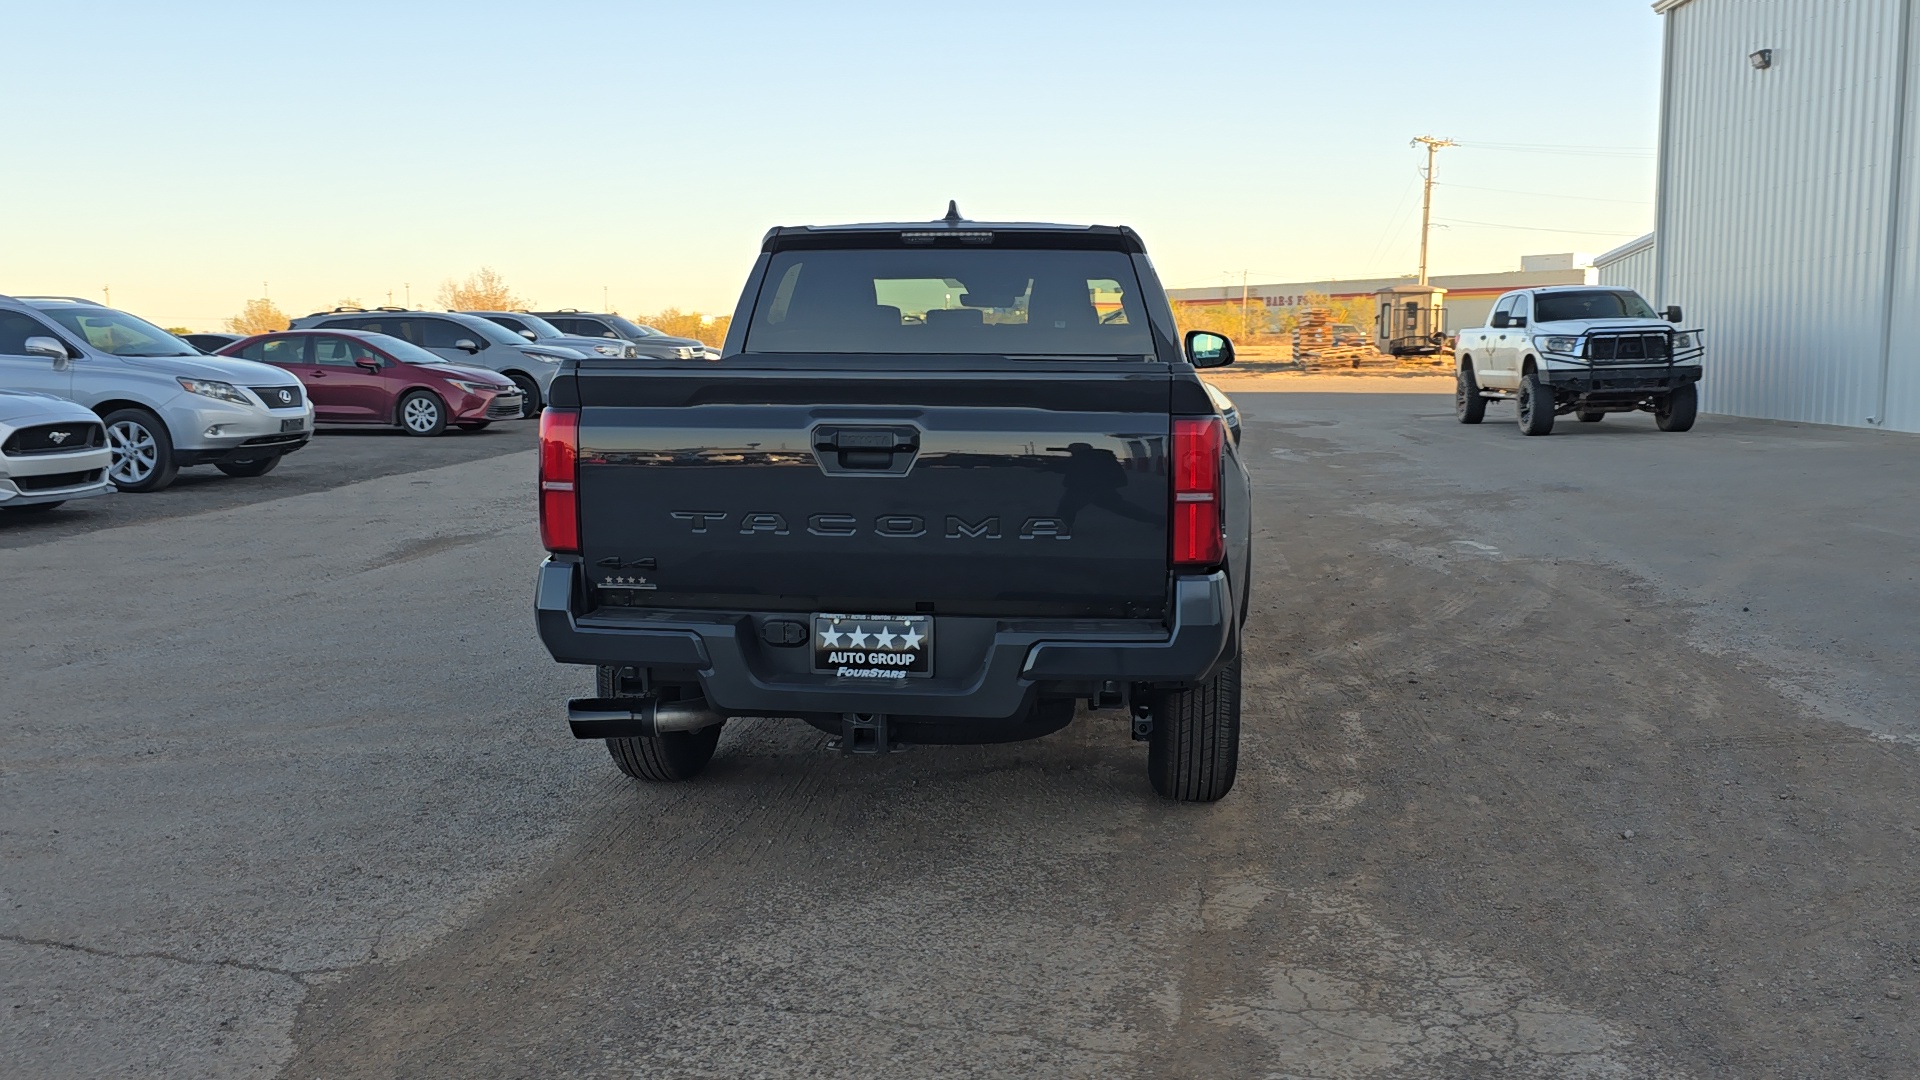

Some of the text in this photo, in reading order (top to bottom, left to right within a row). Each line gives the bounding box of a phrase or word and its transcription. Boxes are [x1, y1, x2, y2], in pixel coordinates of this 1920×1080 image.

[1266, 295, 1293, 306] BAR-S
[670, 511, 1071, 540] TACOMA
[828, 652, 915, 665] AUTO GROUP
